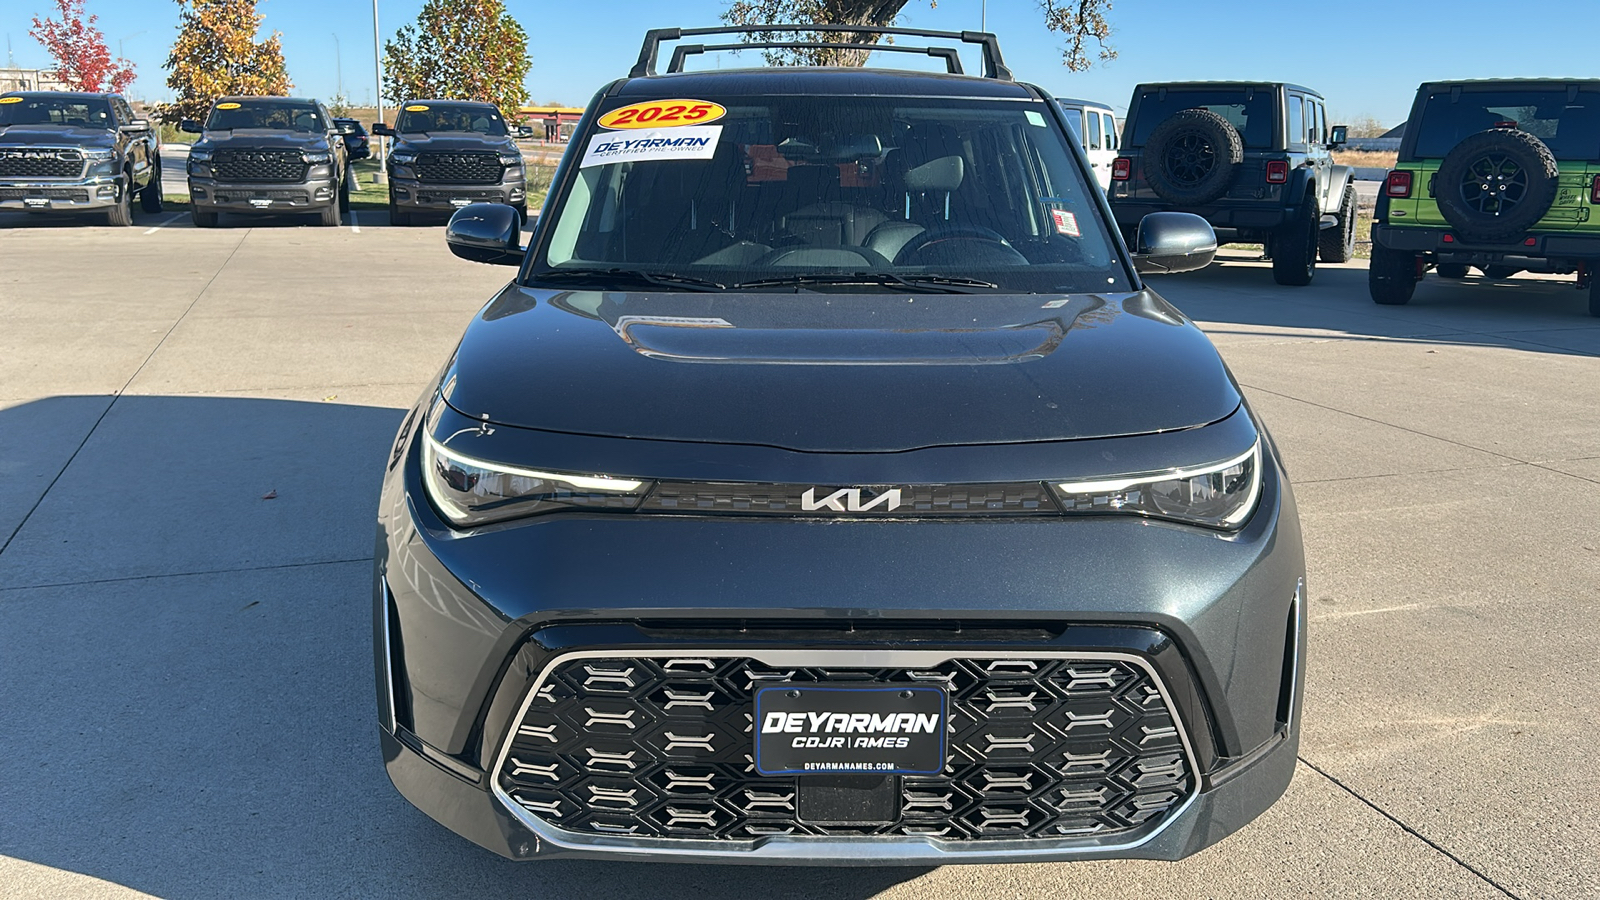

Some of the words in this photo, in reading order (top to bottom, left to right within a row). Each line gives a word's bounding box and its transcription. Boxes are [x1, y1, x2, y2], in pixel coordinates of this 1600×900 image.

[609, 105, 714, 126] 2025
[593, 137, 711, 154] DEYARMAN
[599, 148, 647, 157] CERTIFIED
[801, 487, 901, 511] KIA
[761, 711, 940, 734] DEYARMAN
[791, 736, 846, 748] CDJR
[853, 736, 910, 748] AMES
[804, 762, 894, 771] DEYARMANAMES.COM
